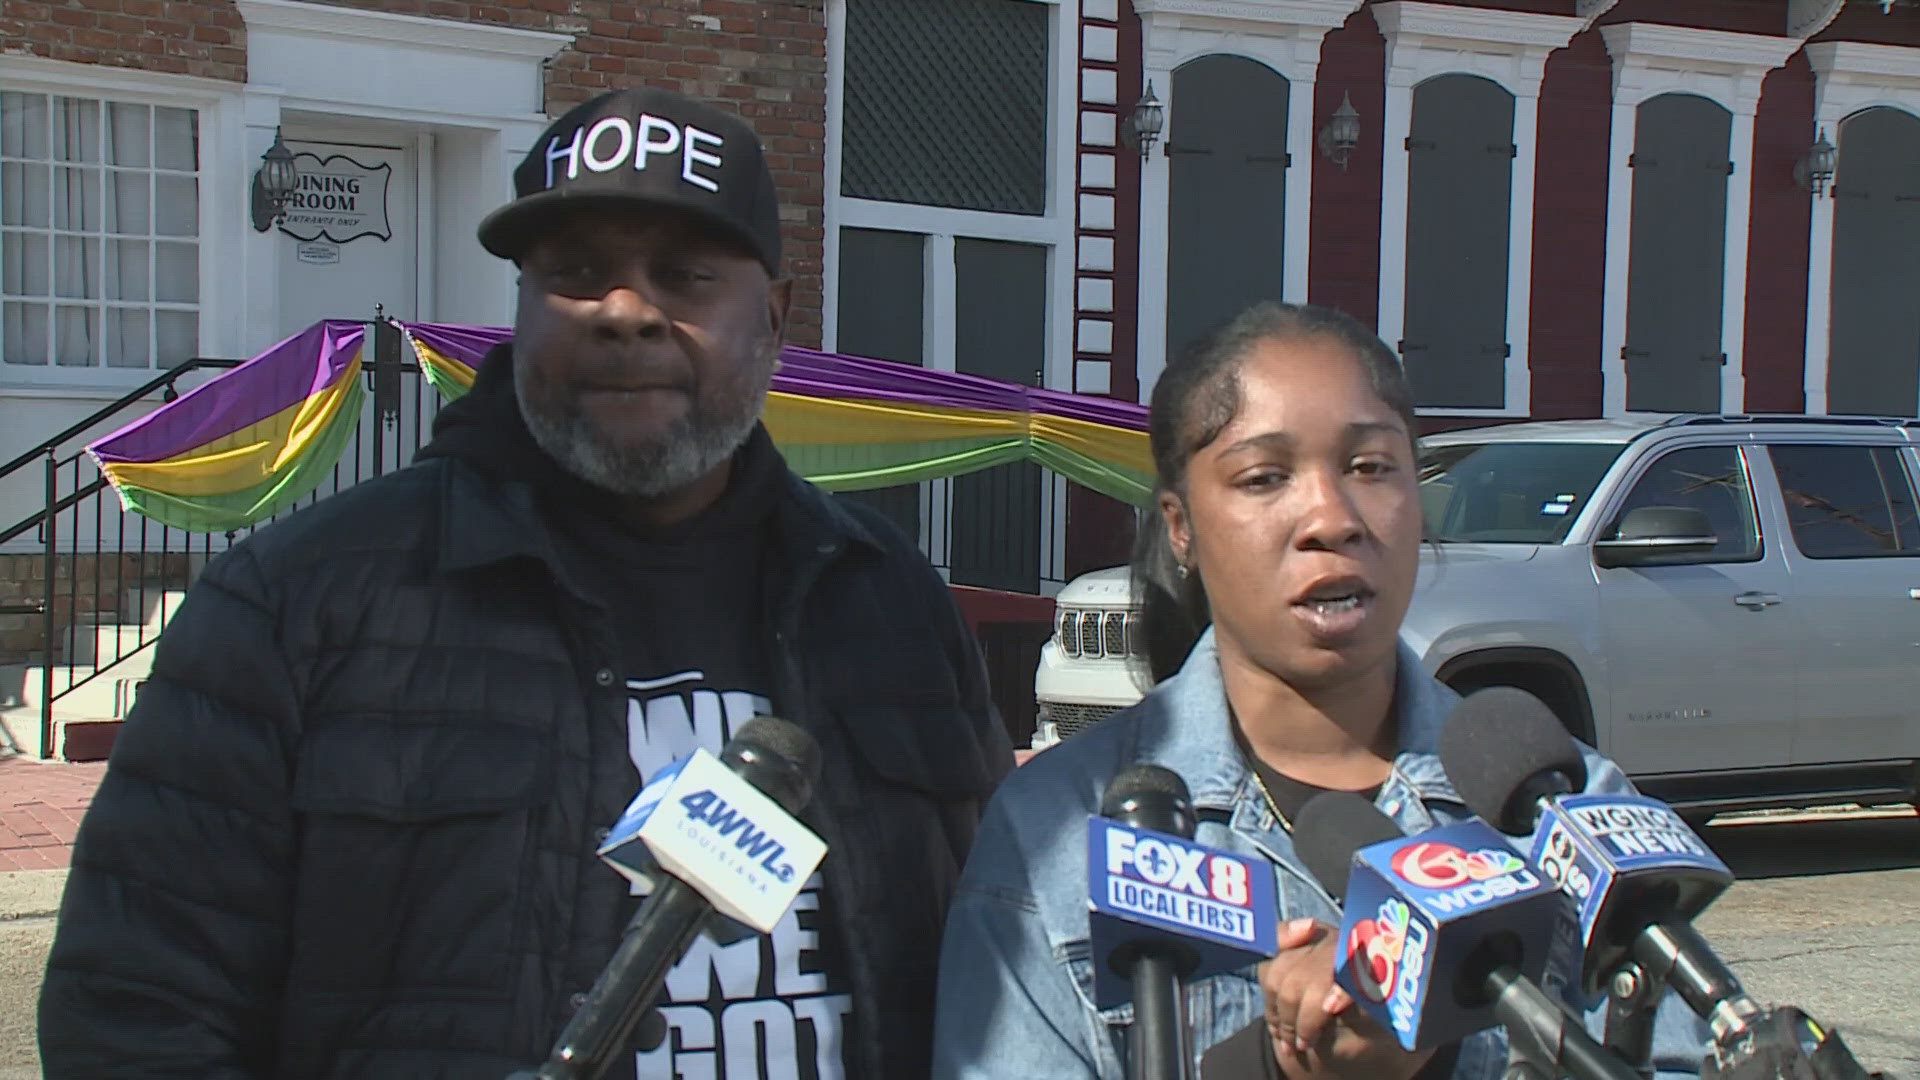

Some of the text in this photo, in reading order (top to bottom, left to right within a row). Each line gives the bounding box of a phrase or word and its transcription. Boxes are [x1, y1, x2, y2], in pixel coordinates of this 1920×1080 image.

[545, 112, 724, 193] HOPE
[286, 214, 361, 226] ENTRANCE ONLY
[292, 192, 355, 211] ROOM
[677, 819, 768, 893] LOUISIANA
[679, 789, 785, 875] 4WWL
[1609, 830, 1705, 857] NEWS
[1113, 881, 1248, 935] LOCAL FIRST
[1424, 868, 1541, 913] WDSU
[1392, 916, 1429, 1033] WDSU
[636, 994, 853, 1080] GOT
